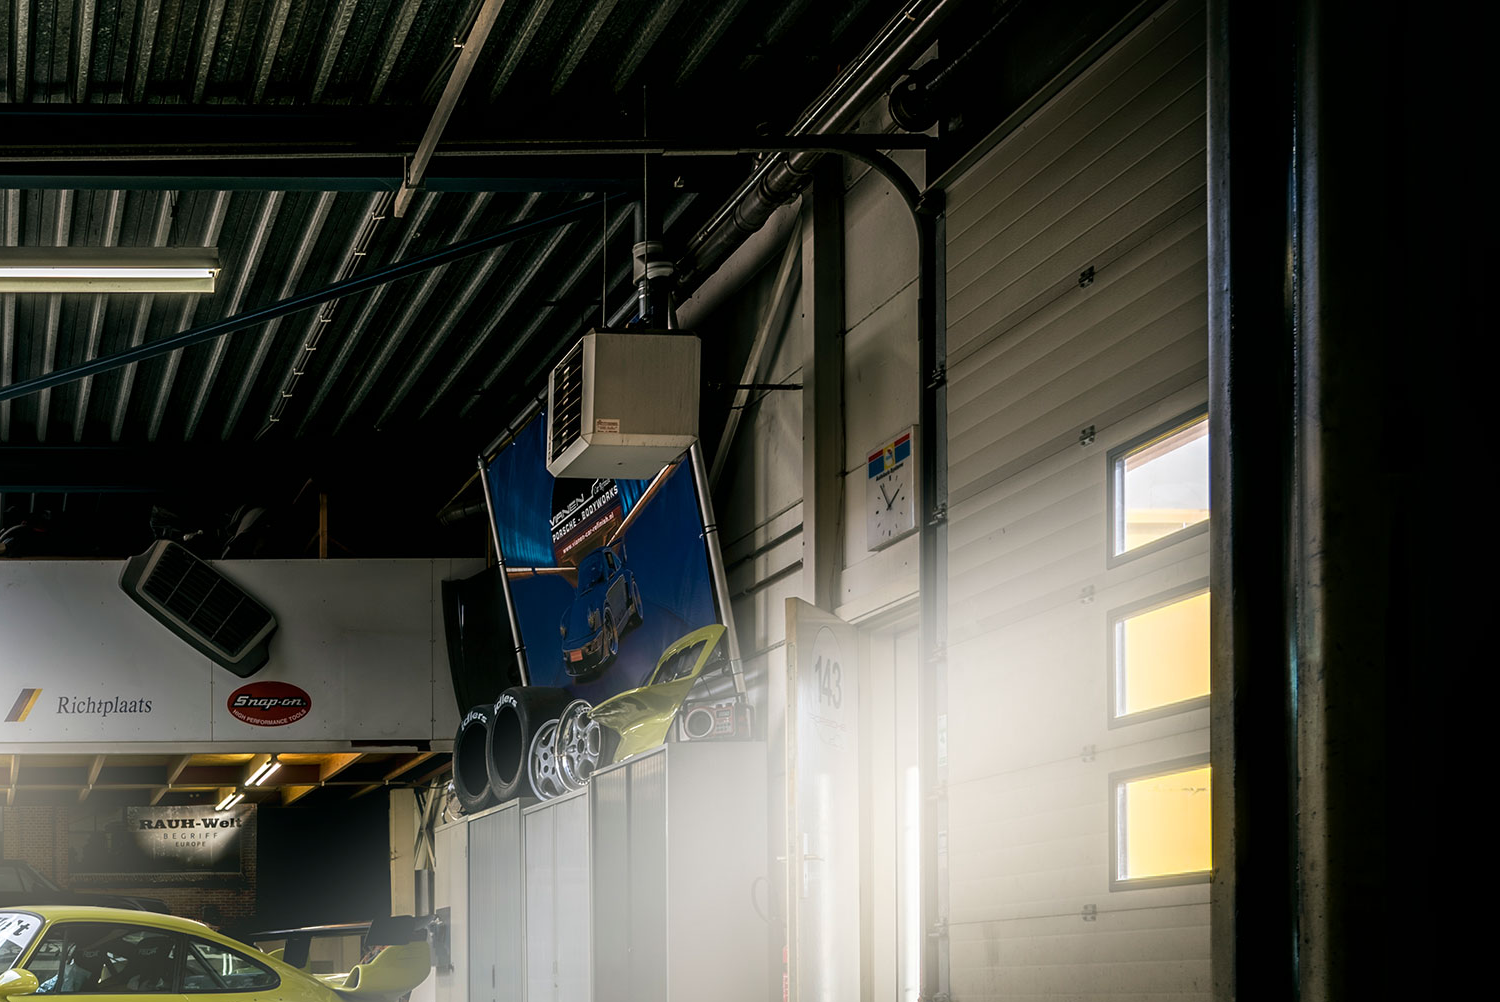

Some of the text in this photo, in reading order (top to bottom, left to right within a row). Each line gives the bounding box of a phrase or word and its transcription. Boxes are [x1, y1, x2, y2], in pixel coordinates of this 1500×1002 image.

[552, 519, 577, 543] PORSCHE
[581, 485, 619, 520] BODYWORKS
[815, 655, 842, 709] 143
[56, 695, 153, 718] Richtplaats
[234, 696, 302, 709] Snap-on
[493, 694, 518, 715] idlers
[232, 709, 307, 725] HIGH PERFORMANCE TOOLS
[461, 710, 488, 731] idlers
[139, 817, 243, 830] RAUH-Welt
[163, 832, 218, 840] BEGRIFF
